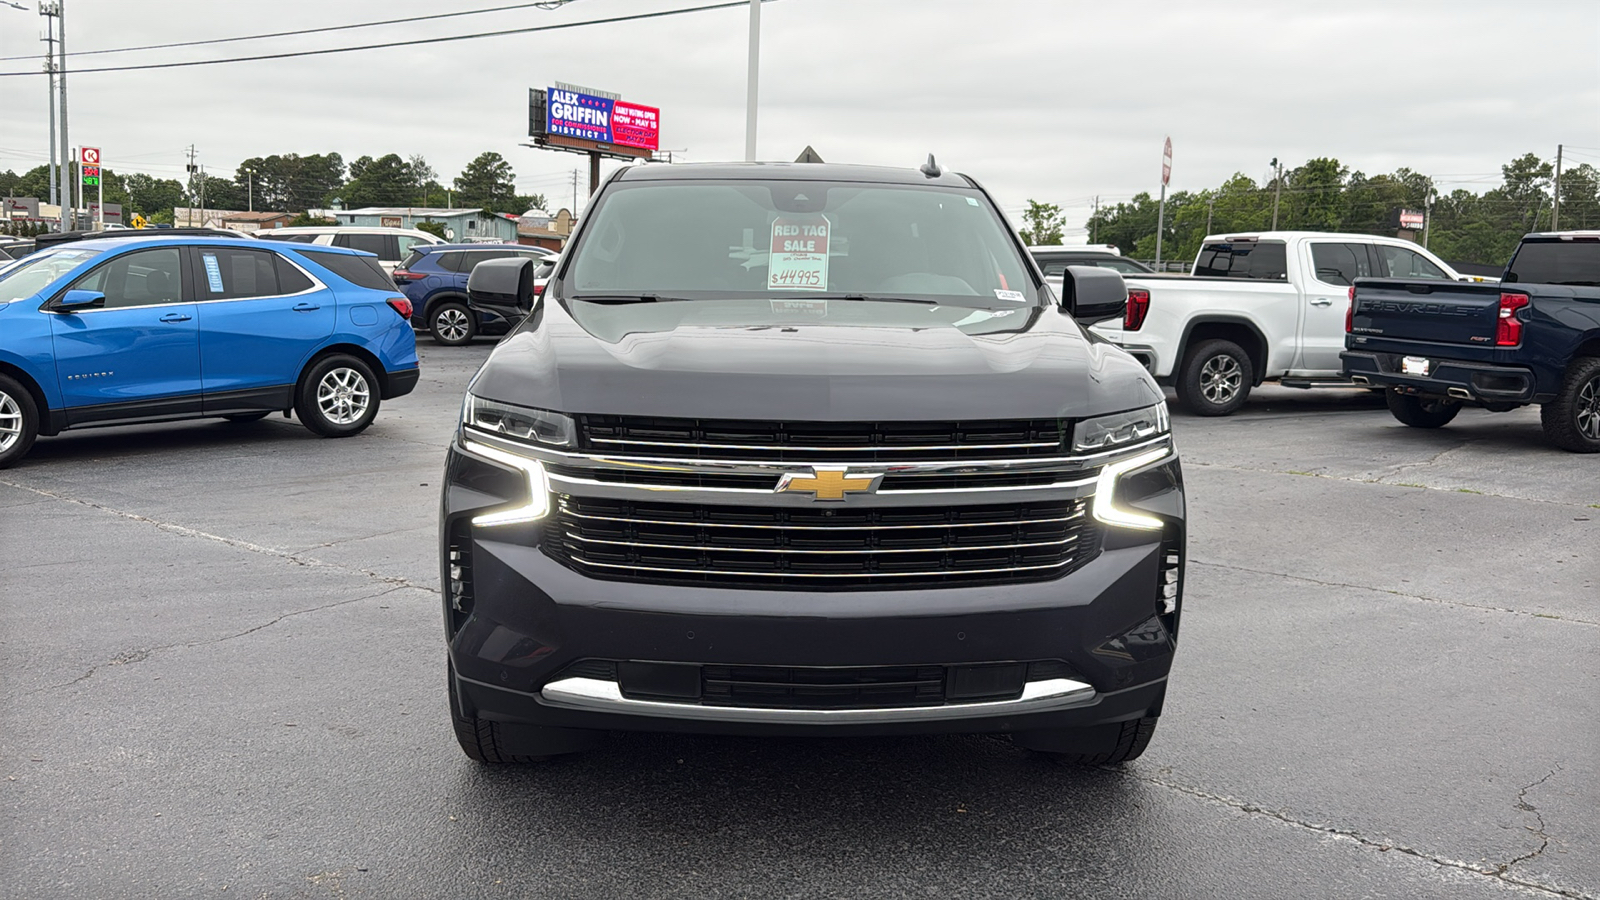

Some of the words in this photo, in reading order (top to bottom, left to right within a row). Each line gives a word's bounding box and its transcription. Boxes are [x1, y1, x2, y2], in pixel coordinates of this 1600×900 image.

[552, 90, 579, 105] ALEX
[551, 103, 607, 127] GRIFFIN
[614, 114, 630, 124] NOW
[635, 118, 649, 127] MAY
[651, 121, 656, 129] 15
[645, 111, 655, 120] OPEN
[552, 118, 563, 126] FOR
[565, 120, 607, 133] COMMISSIONER
[552, 124, 598, 139] DISTRICT
[775, 225, 799, 236] RED
[802, 225, 827, 237] TAG
[783, 240, 816, 252] SALE
[1360, 300, 1485, 317] CHEVROLET
[67, 371, 114, 380] EQUINOX
